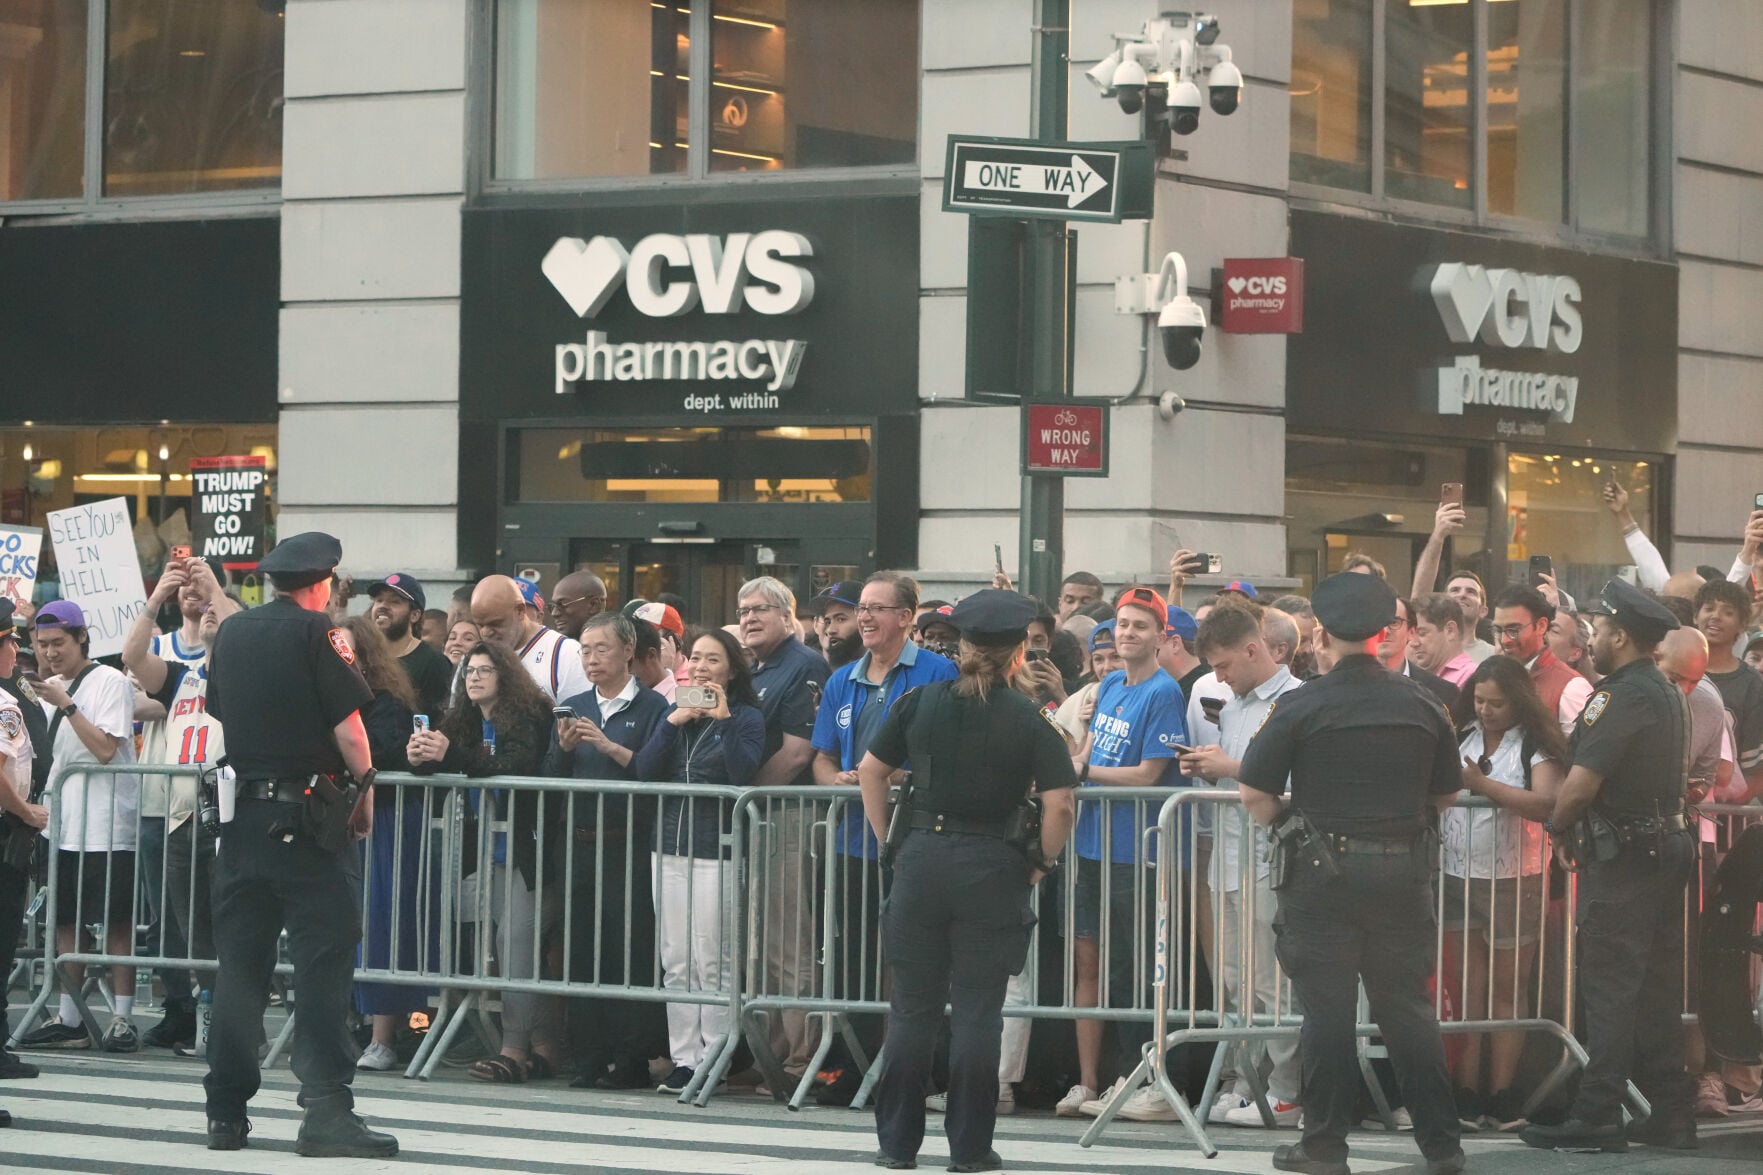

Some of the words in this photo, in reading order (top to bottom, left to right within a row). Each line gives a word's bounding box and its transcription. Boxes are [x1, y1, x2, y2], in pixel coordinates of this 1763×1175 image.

[979, 165, 1022, 189] ONE
[1044, 168, 1092, 193] WAY
[626, 229, 815, 317] CVS
[1247, 276, 1287, 295] CVS
[1230, 296, 1285, 311] pharmacy
[1487, 268, 1583, 354] CVS
[555, 330, 807, 394] pharmacy
[1438, 355, 1579, 424] pharmacy
[684, 393, 725, 413] dept.
[729, 392, 779, 409] within
[1041, 429, 1090, 445] WRONG
[1051, 448, 1079, 464] WAY
[194, 471, 263, 492] TRUMP
[201, 493, 256, 513] MUST
[50, 513, 87, 544] SEE
[84, 506, 115, 538] YOU
[214, 514, 241, 534] GO
[75, 544, 100, 564] IN
[203, 535, 255, 556] NOW!
[61, 567, 118, 598] HELL,
[82, 600, 147, 640] RUMP
[178, 725, 209, 765] 11
